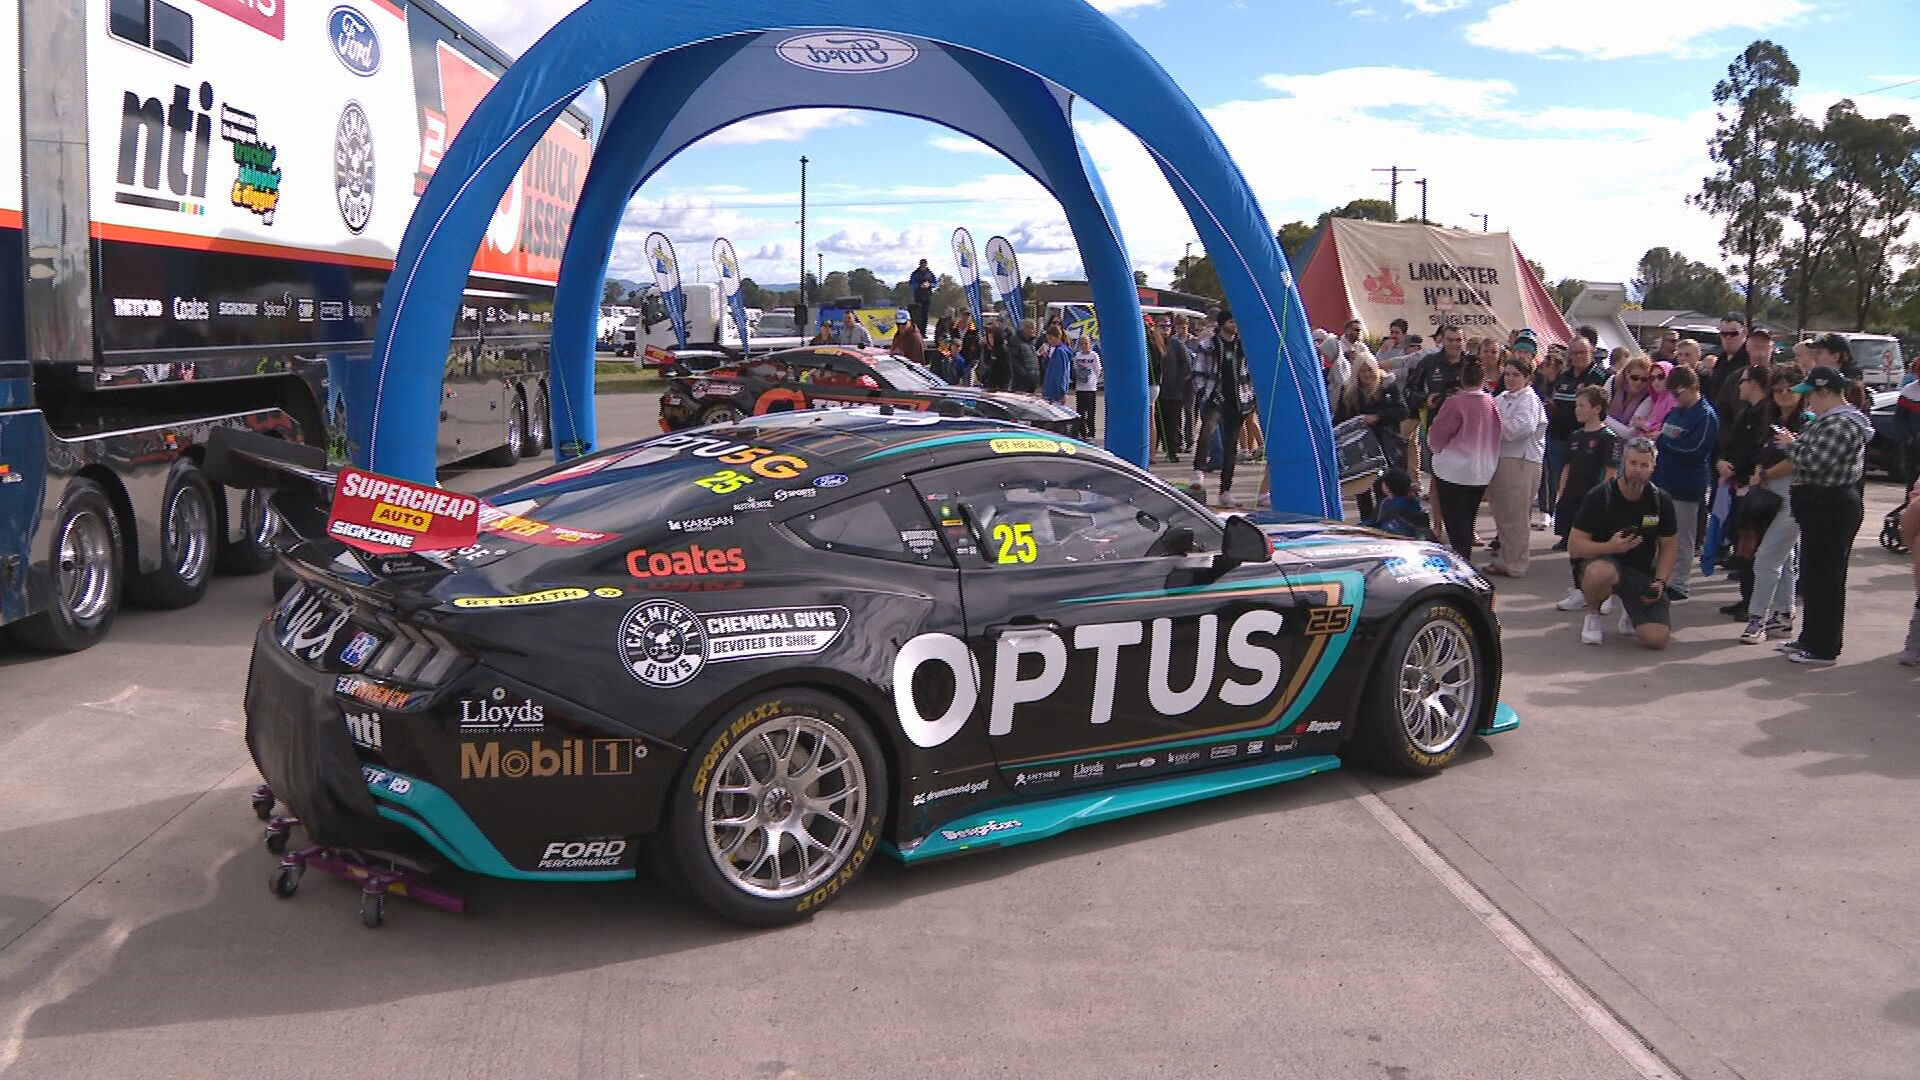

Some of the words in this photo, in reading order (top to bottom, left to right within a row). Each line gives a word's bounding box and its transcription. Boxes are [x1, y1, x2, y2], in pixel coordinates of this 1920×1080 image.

[335, 11, 375, 71] Ford
[116, 81, 213, 198] nti
[524, 137, 578, 205] TRUCK
[521, 196, 571, 260] ASSIS
[1408, 262, 1499, 285] LANCASTER
[113, 298, 162, 317] THETFORD
[174, 296, 209, 320] Coates
[219, 302, 257, 316] SIGNZONE
[1429, 314, 1496, 326] SINGLETON
[995, 440, 1014, 451] RT
[1017, 439, 1055, 451] HEALTH
[694, 470, 754, 494] 25
[342, 472, 477, 522] SUPERCHEAP
[379, 508, 425, 527] AUTO
[682, 515, 734, 528] KANGAN
[331, 520, 414, 549] SIGNZONE
[992, 522, 1038, 565] 25
[626, 544, 747, 578] Coates
[466, 596, 503, 606] RT
[509, 588, 578, 604] HEALTH
[626, 605, 700, 648] CHEMICAL
[706, 613, 793, 635] CHEMICAL
[795, 611, 837, 629] GUYS
[1309, 608, 1350, 632] 25
[713, 638, 766, 653] DEVOTED
[768, 636, 783, 648] TO
[785, 634, 817, 647] SHINE
[644, 657, 694, 682] GUYS
[892, 609, 1284, 748] OPTUS
[336, 676, 410, 709] EARWRENCH
[460, 698, 544, 728] Lloyds
[345, 711, 382, 748] nti
[1306, 720, 1342, 734] Repco
[460, 738, 584, 780] Mobil
[692, 730, 731, 795] SPORT
[730, 700, 783, 737] MAXX
[1026, 770, 1061, 781] ANTHEM
[1073, 761, 1104, 776] Lloyds
[926, 782, 971, 801] drummond
[970, 779, 990, 794] golf
[544, 840, 627, 859] FORD
[538, 856, 622, 869] PERFORMANCE
[796, 830, 875, 912] DUNLOP
